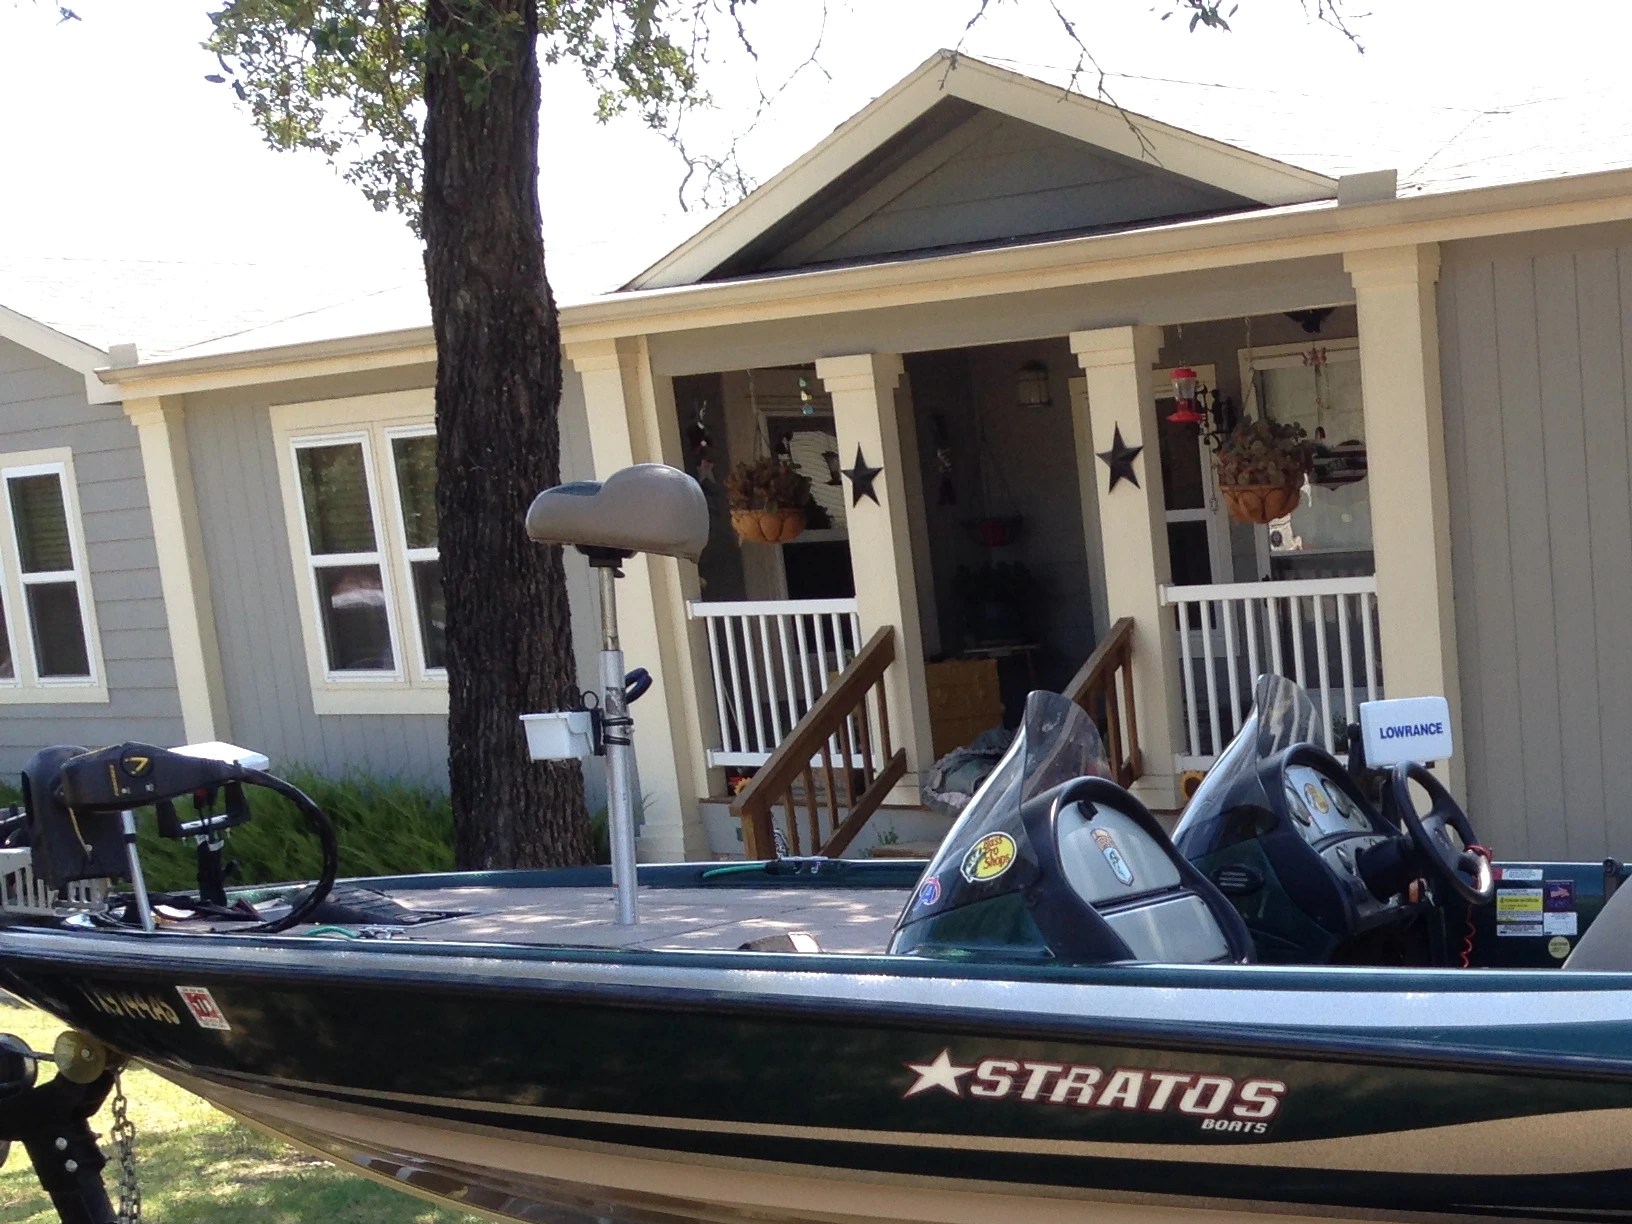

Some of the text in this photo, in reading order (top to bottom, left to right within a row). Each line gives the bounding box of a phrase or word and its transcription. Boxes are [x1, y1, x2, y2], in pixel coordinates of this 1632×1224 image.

[1379, 722, 1444, 740] LOWRANCE
[969, 1058, 1288, 1119] STRATOS
[1201, 1118, 1269, 1134] BOATS
